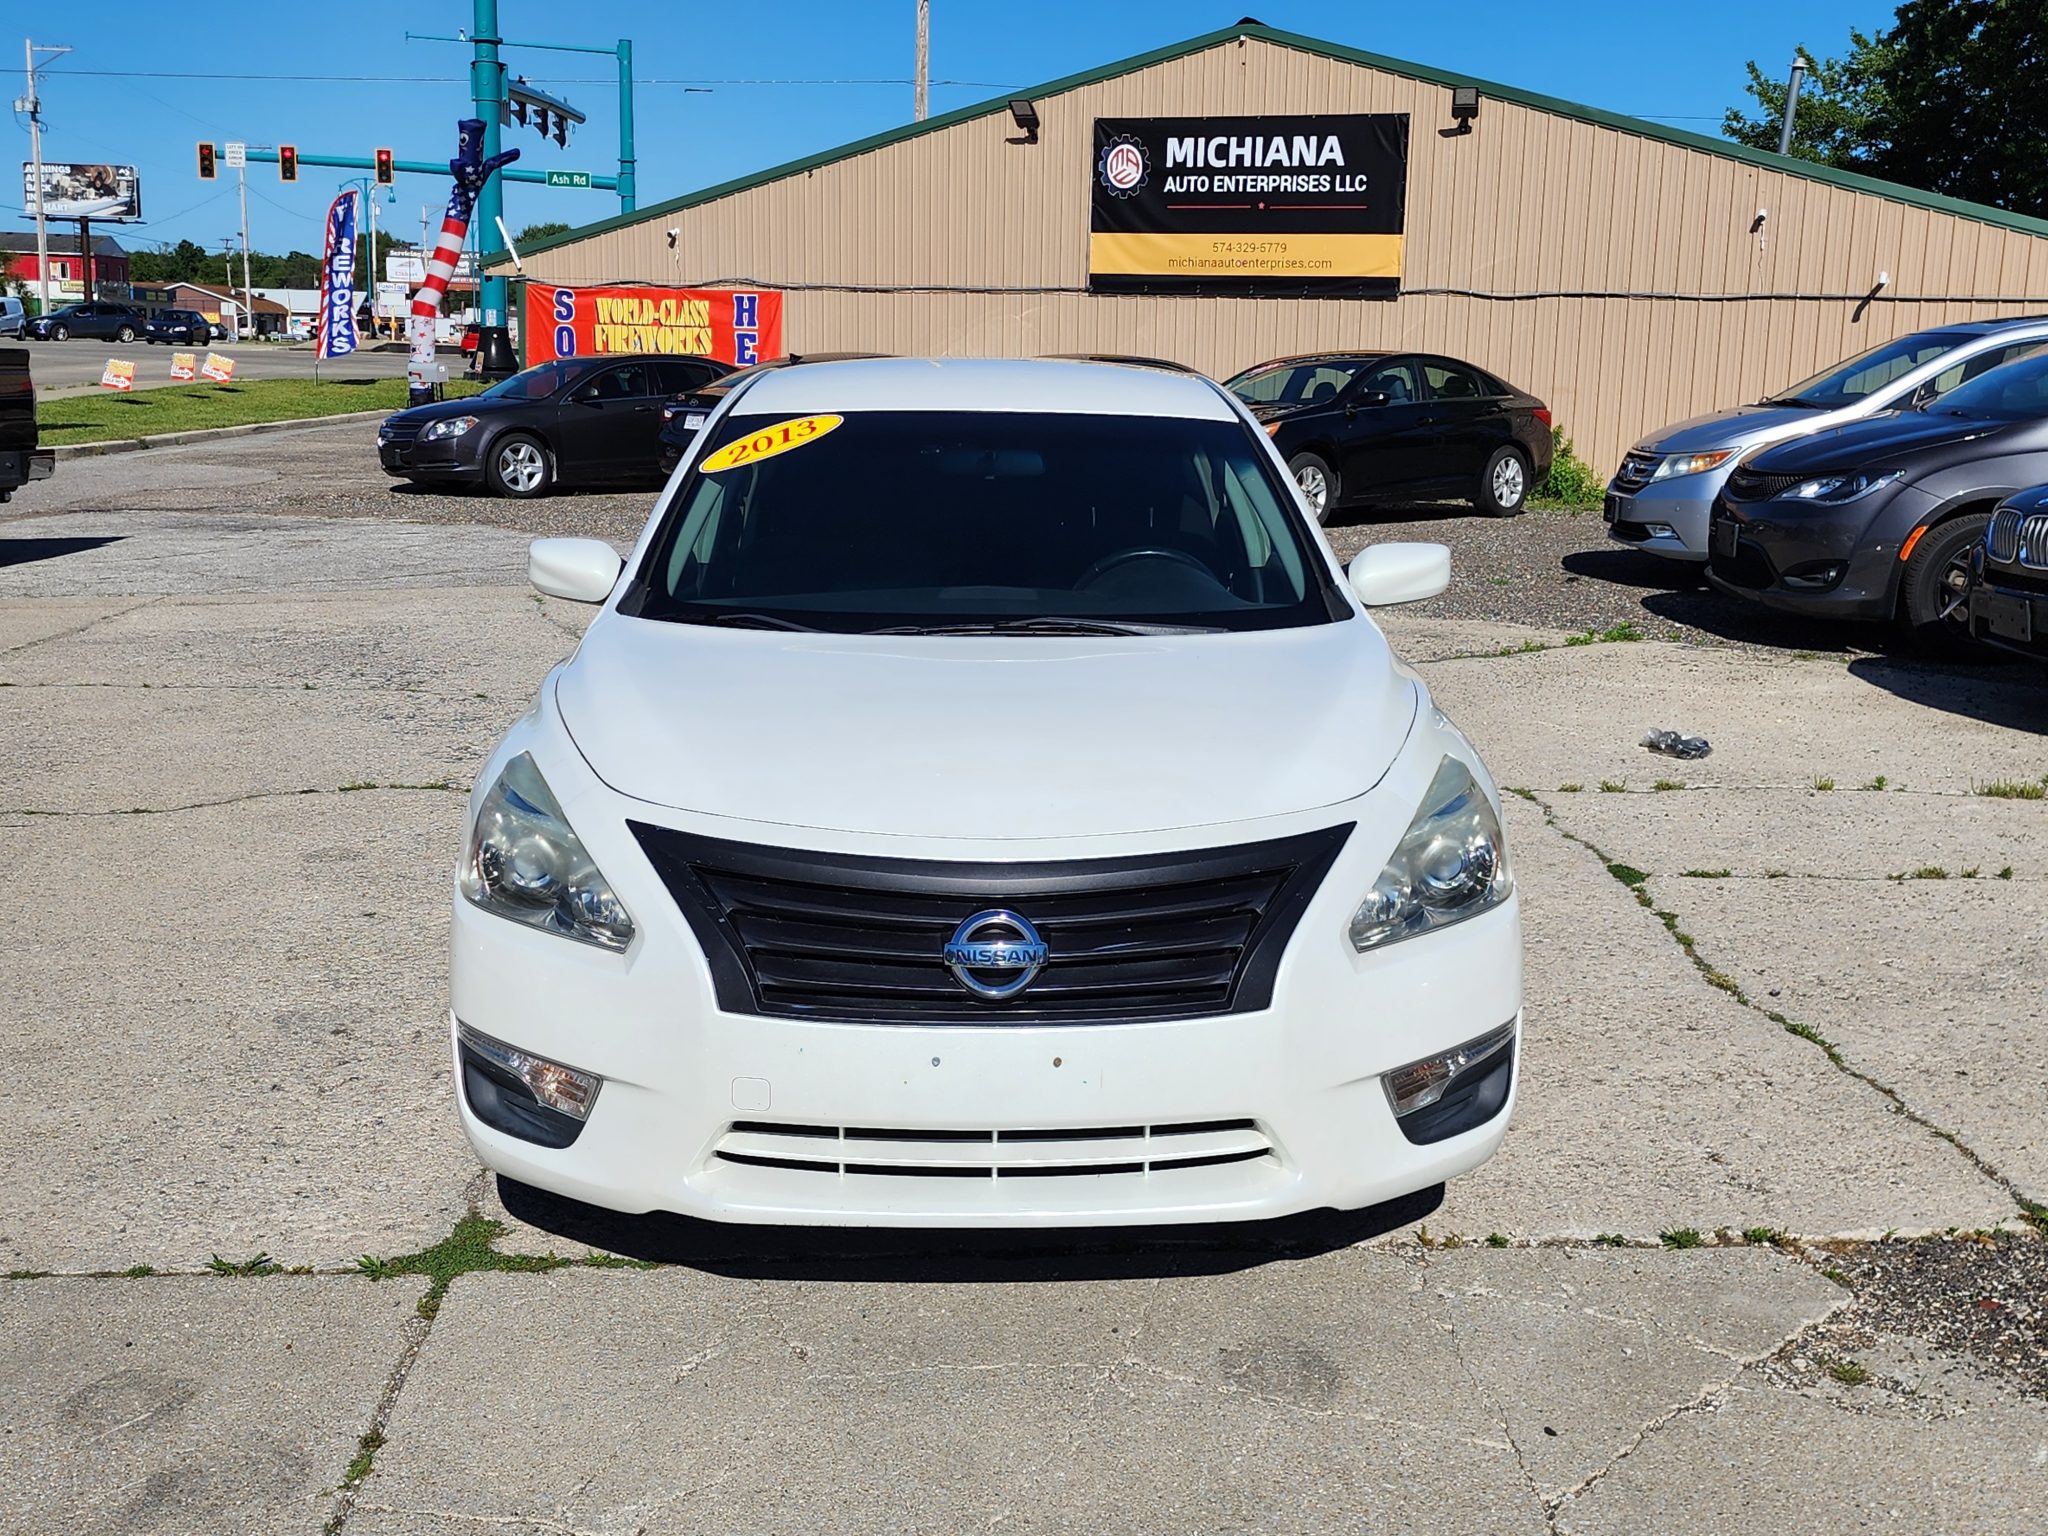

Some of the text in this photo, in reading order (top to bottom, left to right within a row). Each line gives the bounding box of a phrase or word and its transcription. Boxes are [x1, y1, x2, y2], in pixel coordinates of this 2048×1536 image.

[1166, 135, 1345, 168] MICHIANA
[551, 173, 587, 185] Ash Rd
[1163, 174, 1368, 193] AUTO ENTERPRISES LLC
[1212, 242, 1288, 253] 574-329-5779
[1168, 256, 1333, 270] michianaautoenterprises.com
[595, 297, 710, 327] WORLD-CLASS
[594, 324, 713, 355] FIREWORKS
[728, 420, 817, 465] 2013
[956, 949, 1038, 963] NISSAN
